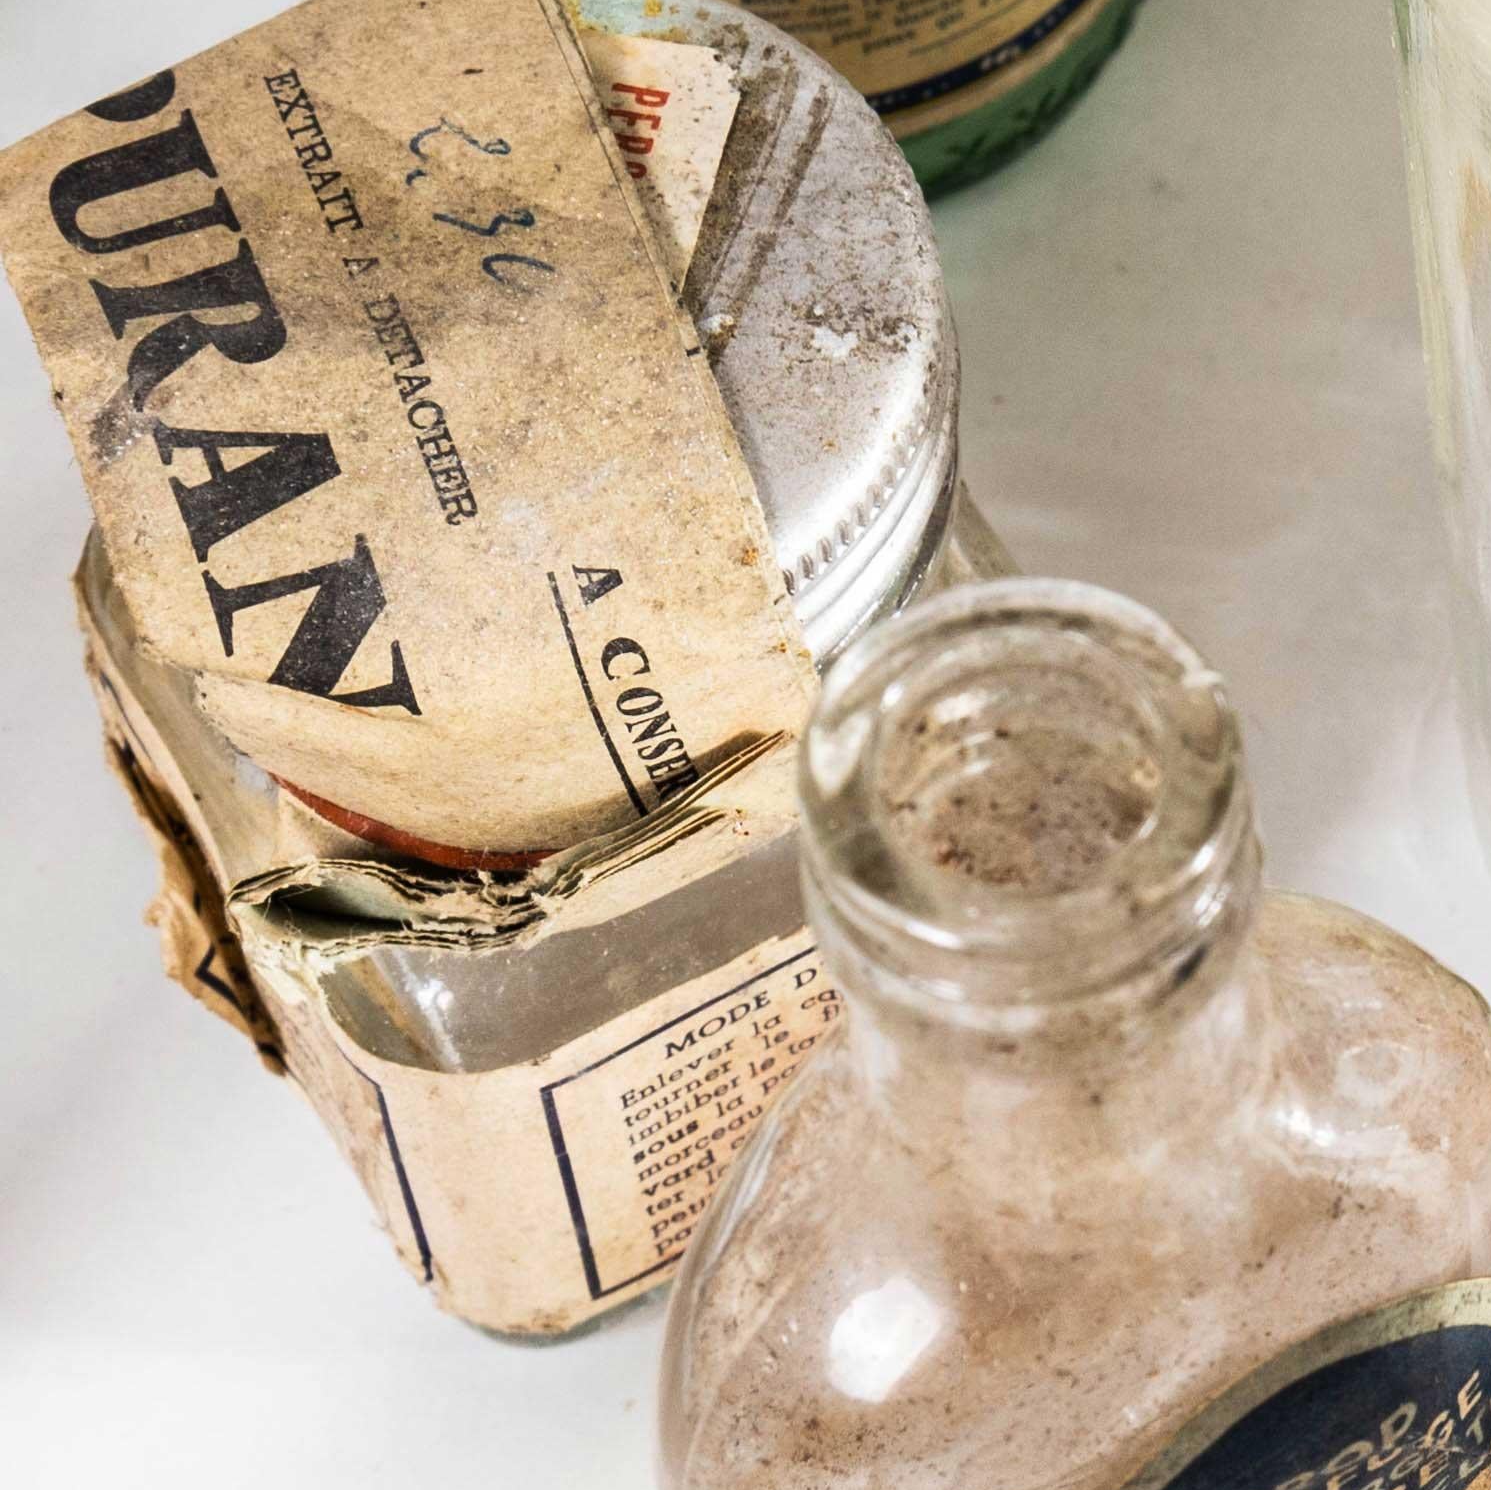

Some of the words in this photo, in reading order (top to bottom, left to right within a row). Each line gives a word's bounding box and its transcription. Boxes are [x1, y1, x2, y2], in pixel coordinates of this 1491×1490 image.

[263, 67, 370, 240] EXTRAIT
[341, 253, 382, 290] A
[363, 294, 480, 528] DETACHER
[571, 563, 624, 607] A
[620, 1037, 738, 1110] Enlever
[751, 1011, 783, 1038] la
[663, 989, 772, 1059] MODE
[623, 1059, 734, 1128] tourner
[762, 1025, 791, 1051] le
[627, 1072, 742, 1147] imbiber
[747, 1053, 777, 1079] le
[632, 1118, 701, 1165] sous
[715, 1092, 746, 1119] la
[637, 1102, 765, 1183] morceau
[641, 1148, 716, 1198] vard
[645, 1187, 687, 1218] ter
